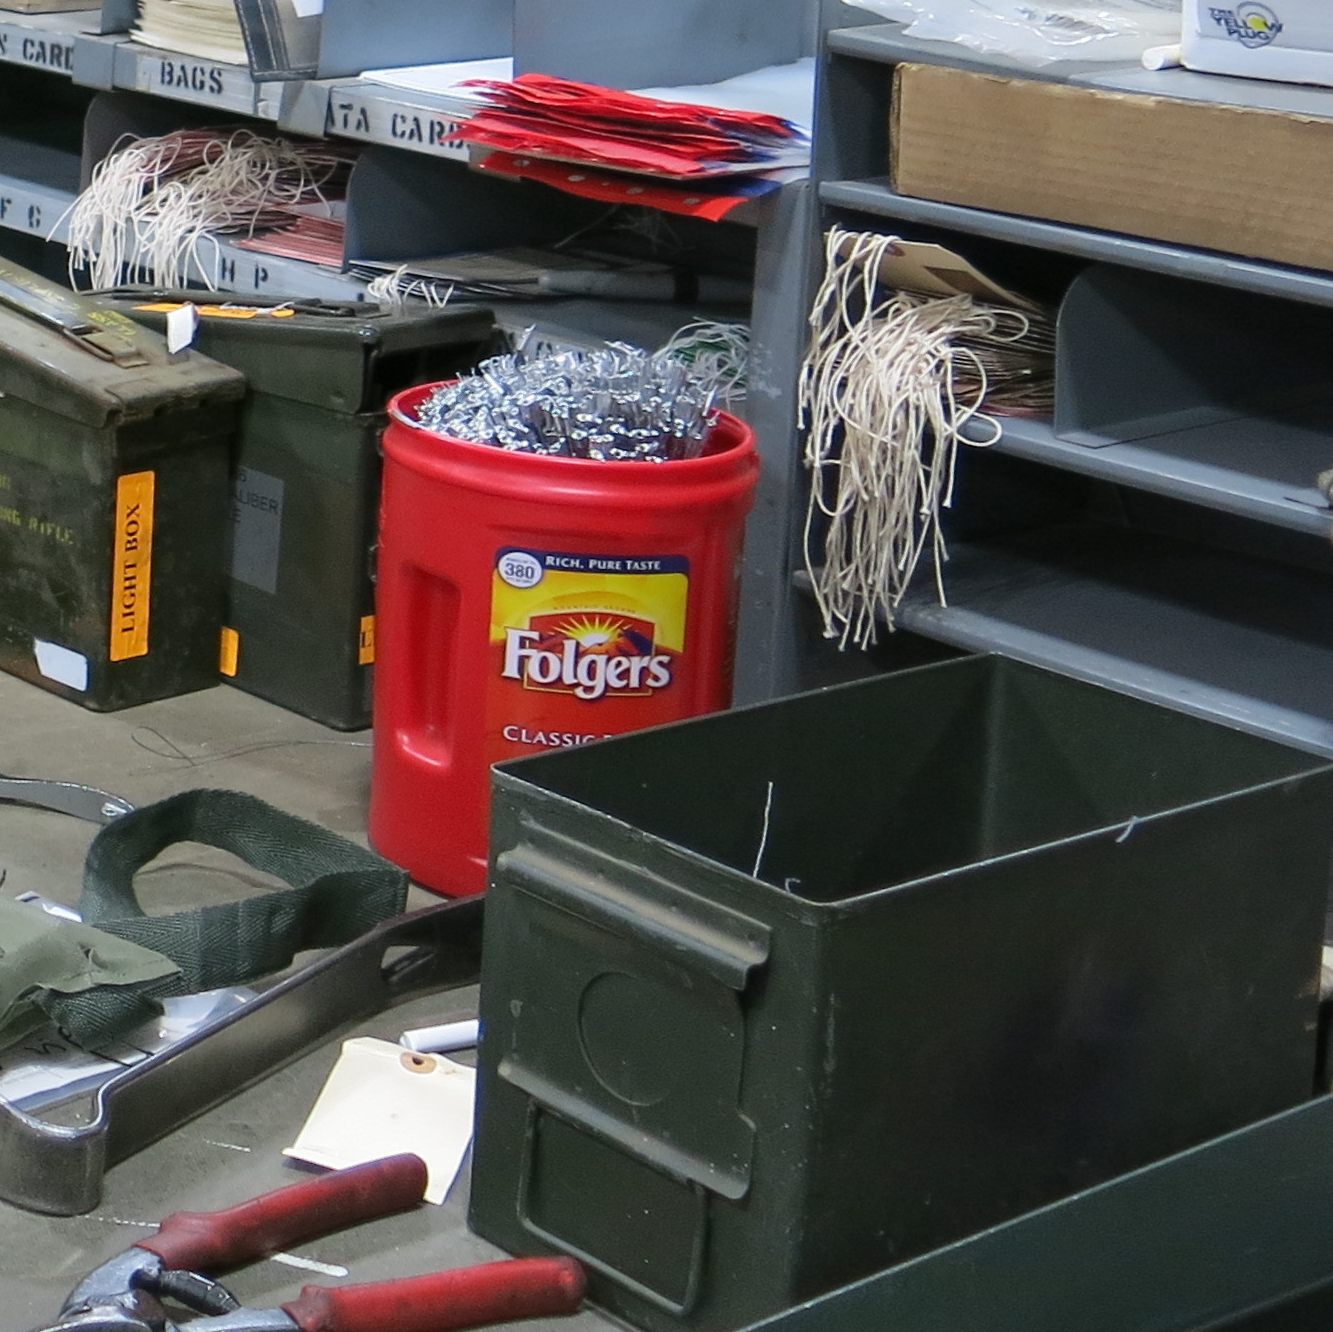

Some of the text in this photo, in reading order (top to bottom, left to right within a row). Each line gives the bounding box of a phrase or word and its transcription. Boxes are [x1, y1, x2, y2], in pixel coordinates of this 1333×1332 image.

[1227, 29, 1271, 41] PLUG
[160, 61, 224, 95] BAGS
[121, 503, 141, 634] LIGHT BOX
[504, 562, 535, 579] 380
[589, 560, 622, 571] PURE
[626, 560, 661, 571] TASTE
[501, 626, 672, 700] Folgers
